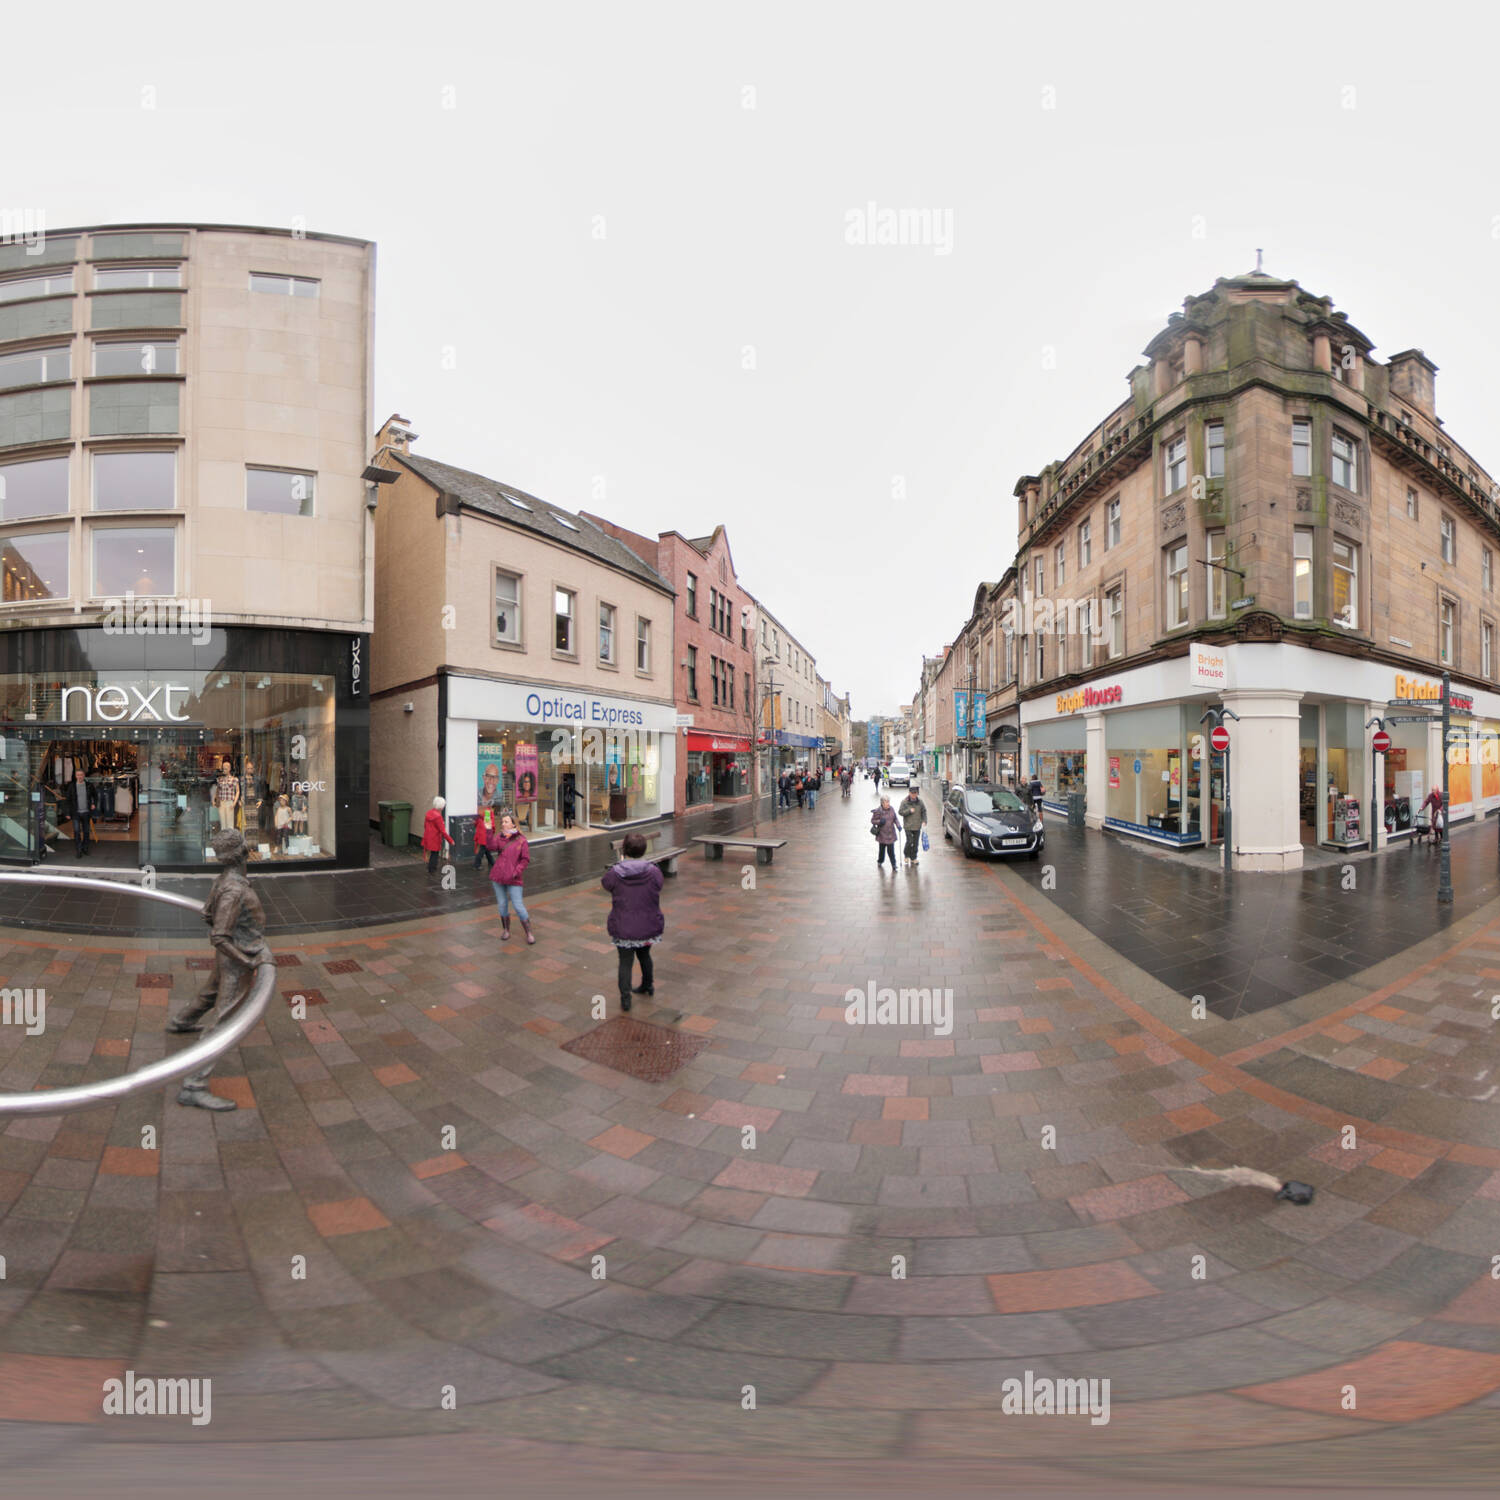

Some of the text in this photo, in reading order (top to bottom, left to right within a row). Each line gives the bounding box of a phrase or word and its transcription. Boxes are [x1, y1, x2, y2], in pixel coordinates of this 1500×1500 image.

[352, 638, 360, 694] next
[1198, 653, 1223, 667] Bright
[1198, 666, 1223, 678] House
[62, 684, 190, 721] next
[526, 693, 643, 726] Optical Express
[479, 745, 501, 754] FREE
[516, 746, 537, 755] FREE
[292, 780, 327, 792] next
